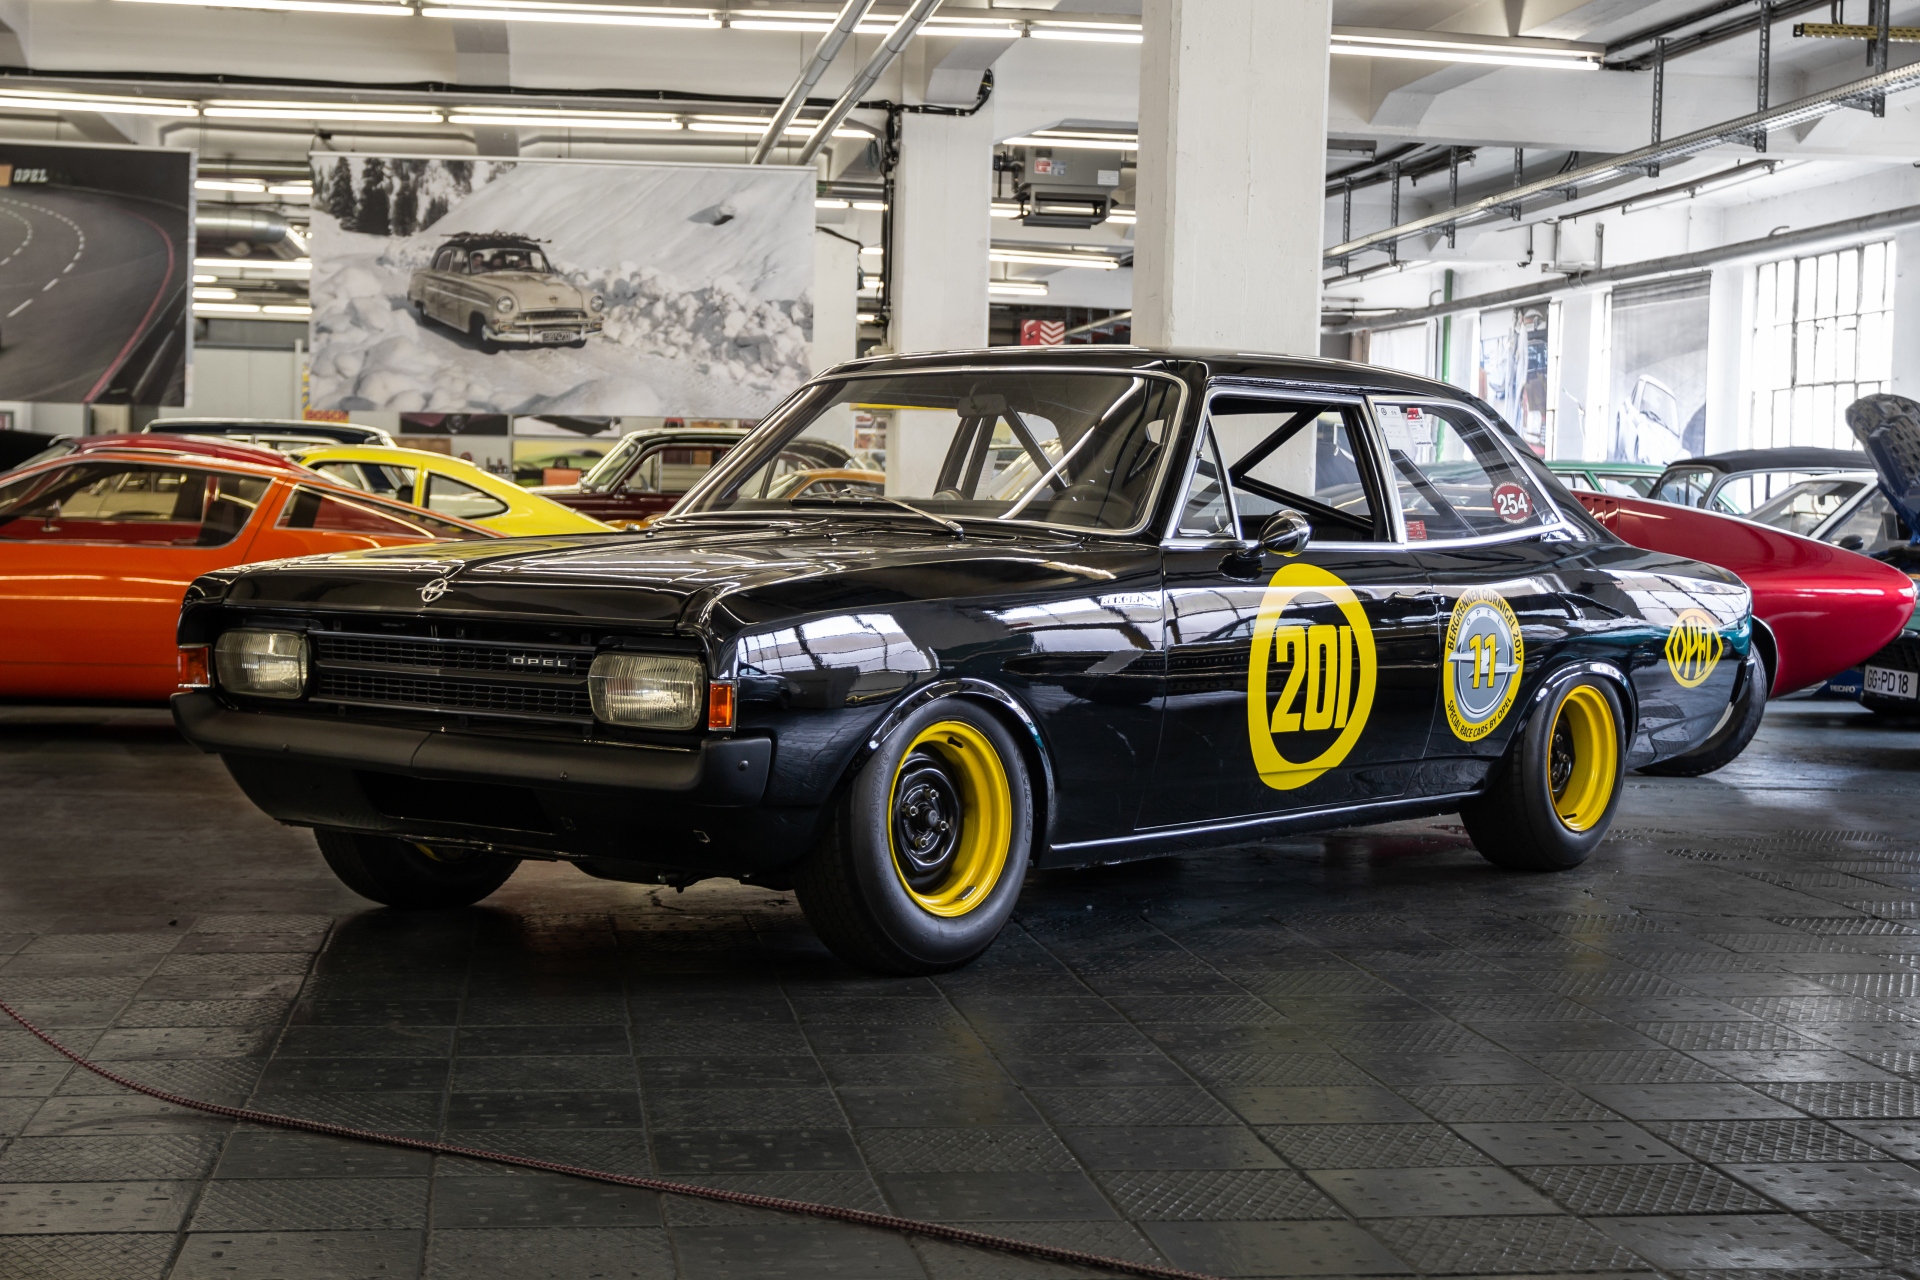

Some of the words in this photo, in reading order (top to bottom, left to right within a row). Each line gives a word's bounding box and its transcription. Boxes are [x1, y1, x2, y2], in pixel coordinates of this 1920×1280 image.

[13, 168, 49, 182] OPEL
[1497, 492, 1528, 515] 254
[1447, 589, 1480, 650] BERGRENNEN
[1482, 589, 1516, 630] GURNIGEL
[1513, 630, 1522, 662] 2017
[1466, 609, 1502, 626] OPEL
[513, 657, 567, 667] OPEL
[1469, 633, 1496, 689] 11
[1672, 616, 1716, 679] OPEL
[1270, 624, 1352, 733] 201
[1830, 684, 1856, 694] RECARO
[1898, 673, 1909, 694] 18
[1448, 700, 1461, 731] SPECIAL
[1459, 725, 1473, 738] RACE
[1473, 724, 1488, 737] CARS
[1490, 716, 1498, 729] BY
[1498, 697, 1512, 719] OPEL
[870, 750, 890, 834] RACING
